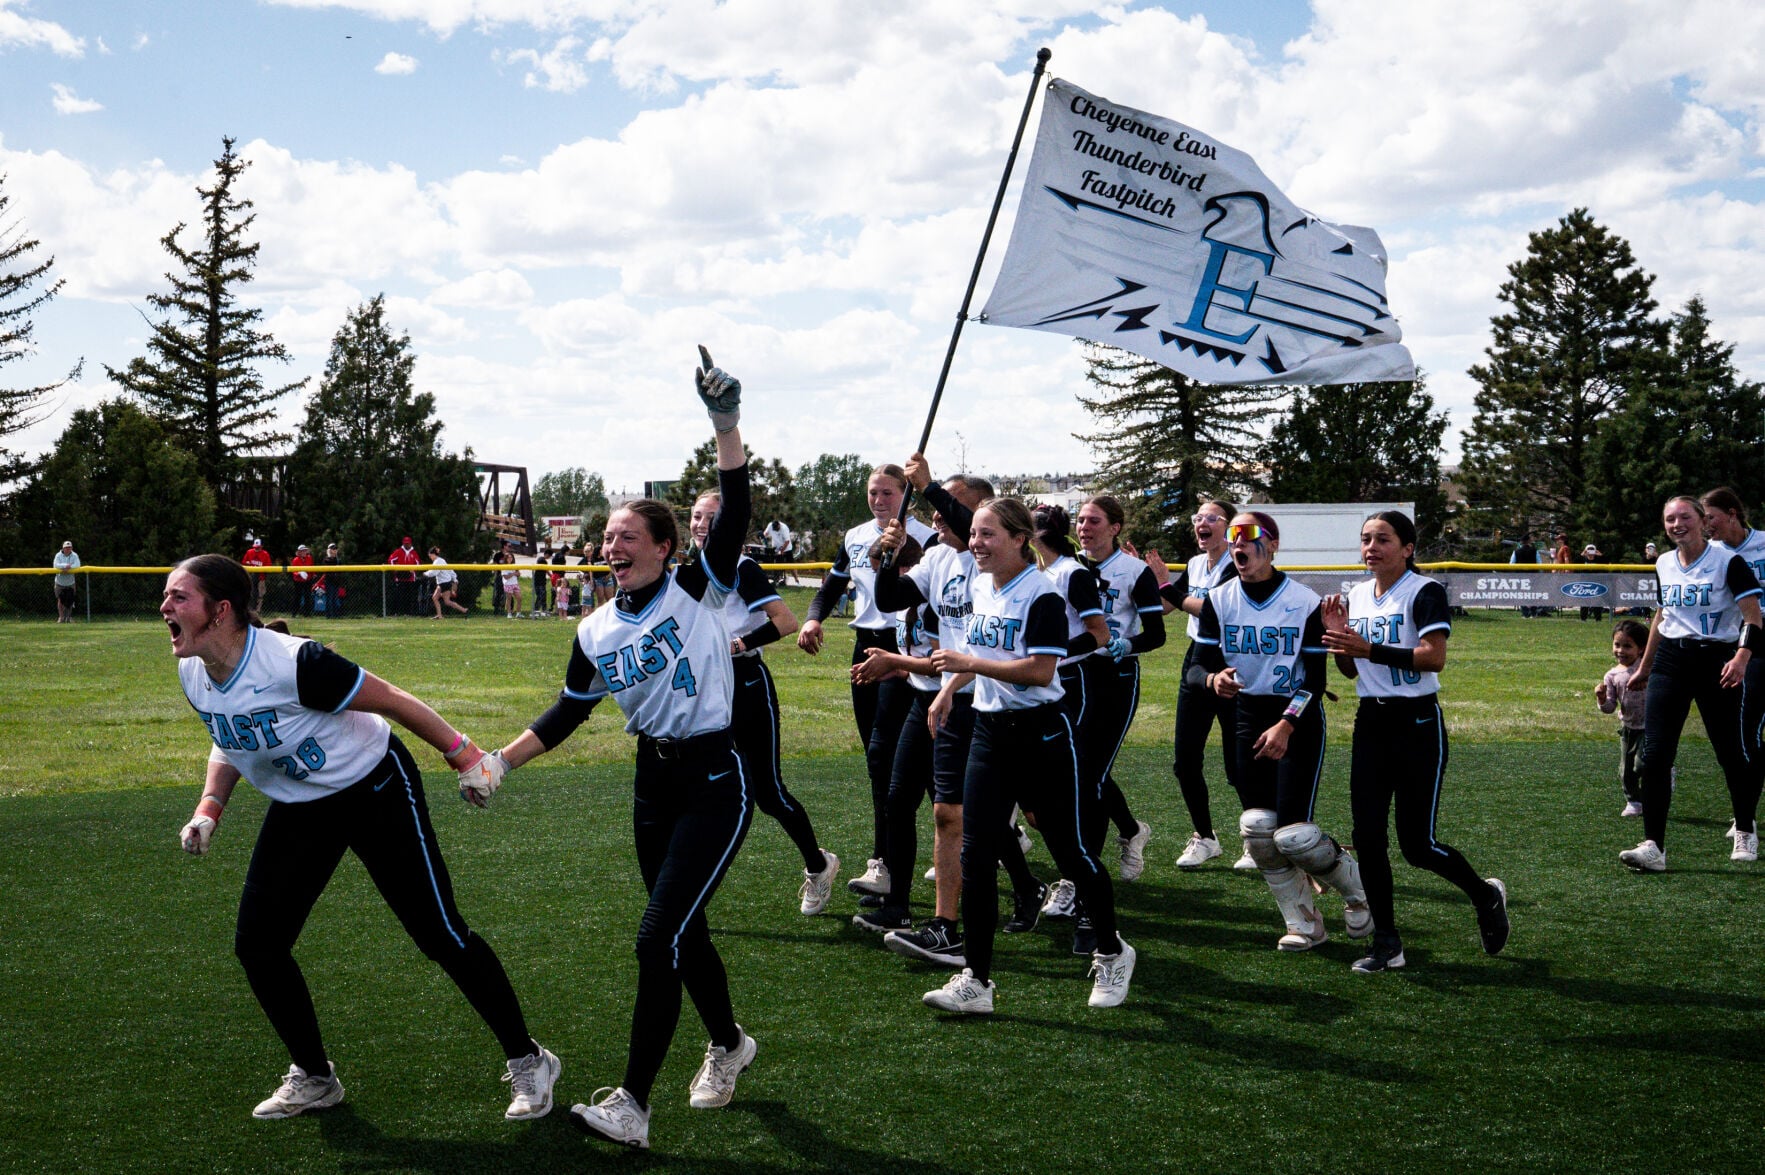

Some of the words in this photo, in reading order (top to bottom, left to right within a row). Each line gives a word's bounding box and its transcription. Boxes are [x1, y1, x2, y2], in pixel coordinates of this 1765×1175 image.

[1070, 95, 1170, 146] Cheyenne
[1173, 131, 1217, 160] East
[1072, 129, 1207, 192] Thunderbird
[1080, 169, 1176, 219] Fastpitch
[1173, 236, 1276, 345] E
[850, 544, 872, 569] EA
[1460, 591, 1549, 600] CHAMPIONSHIPS
[1476, 578, 1532, 590] STATE
[1569, 583, 1600, 596] Ford
[1660, 583, 1713, 606] EAST
[1224, 624, 1300, 656] EAST
[1699, 611, 1723, 636] 17
[596, 616, 684, 694] EAST
[671, 656, 698, 698] 4
[199, 708, 283, 752] EAST
[272, 736, 327, 781] 28
